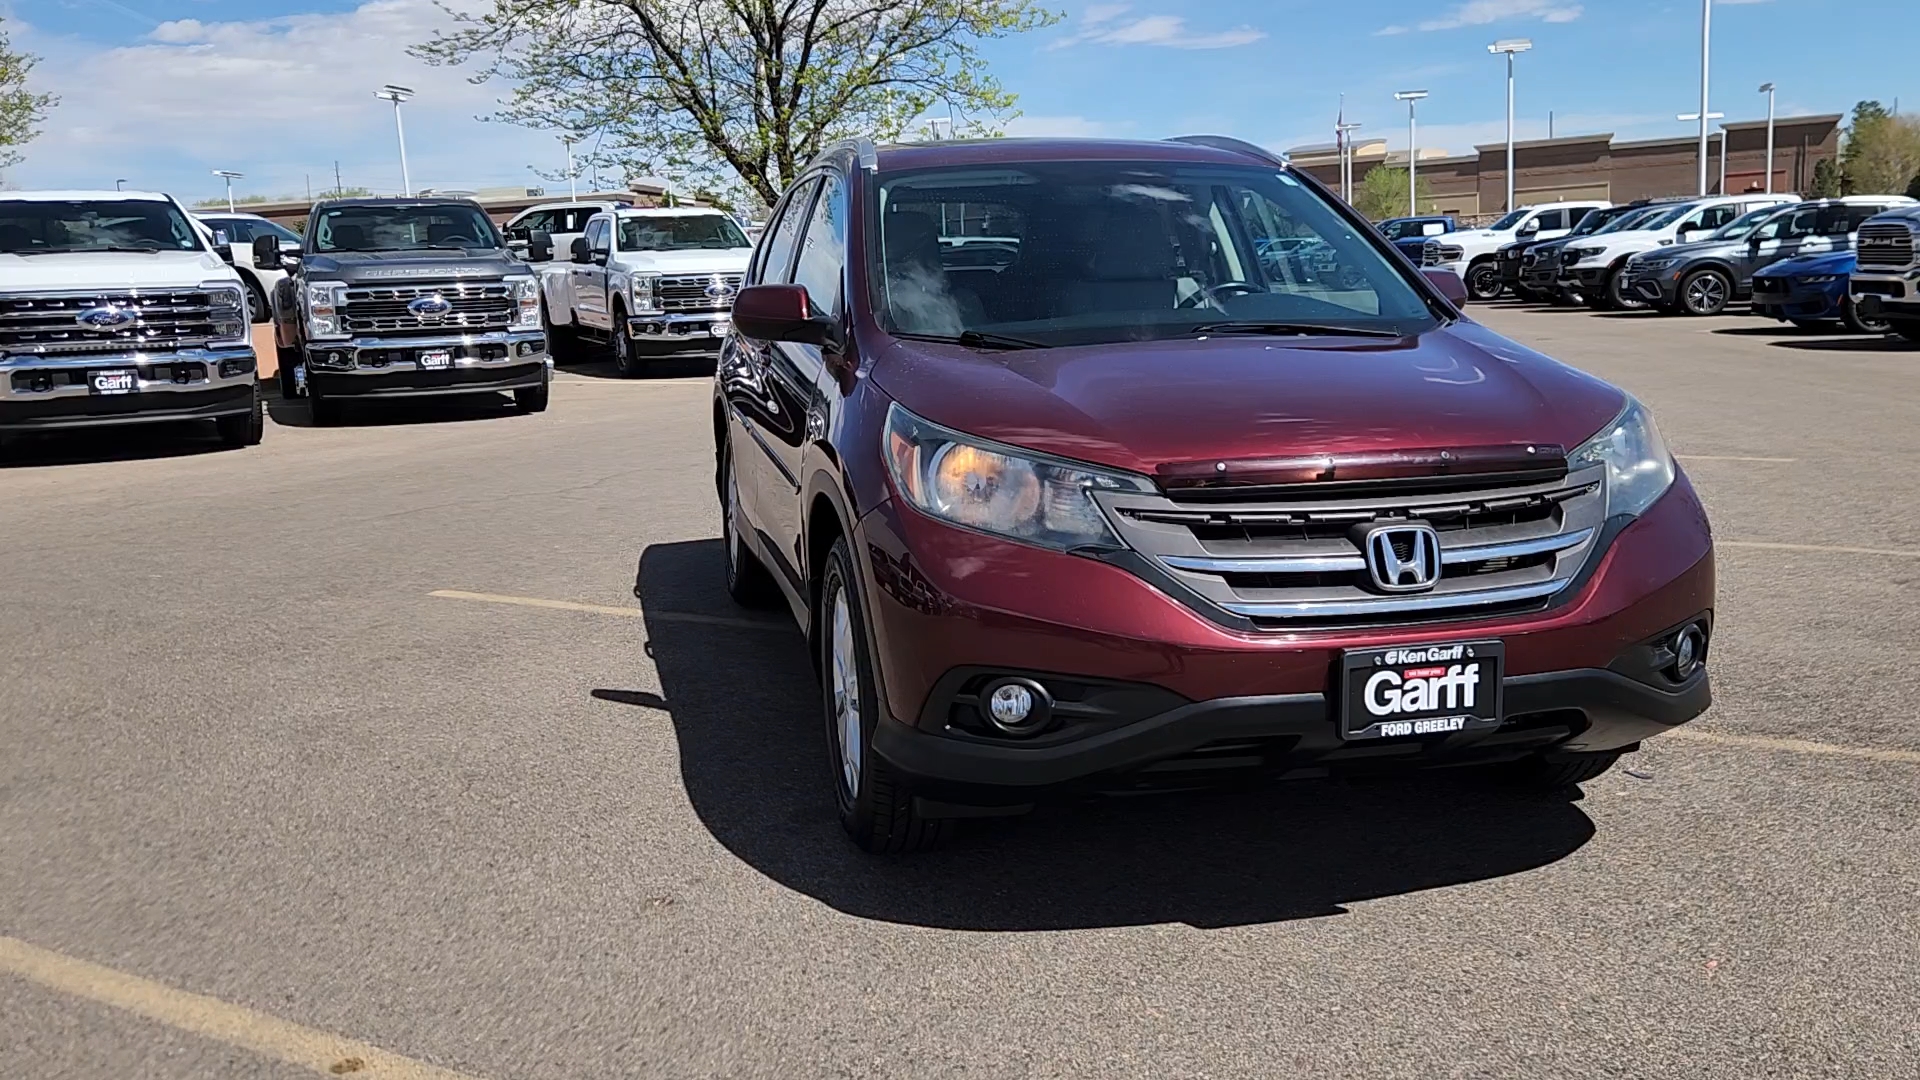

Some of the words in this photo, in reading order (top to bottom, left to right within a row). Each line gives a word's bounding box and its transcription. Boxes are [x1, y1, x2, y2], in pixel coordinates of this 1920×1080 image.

[421, 354, 450, 366] Garff
[94, 375, 132, 390] Garff
[1398, 650, 1427, 664] Ken
[1427, 645, 1464, 662] Garff
[1364, 663, 1480, 716] Garff
[1381, 722, 1412, 737] FORD
[1414, 717, 1466, 735] GREELEY
